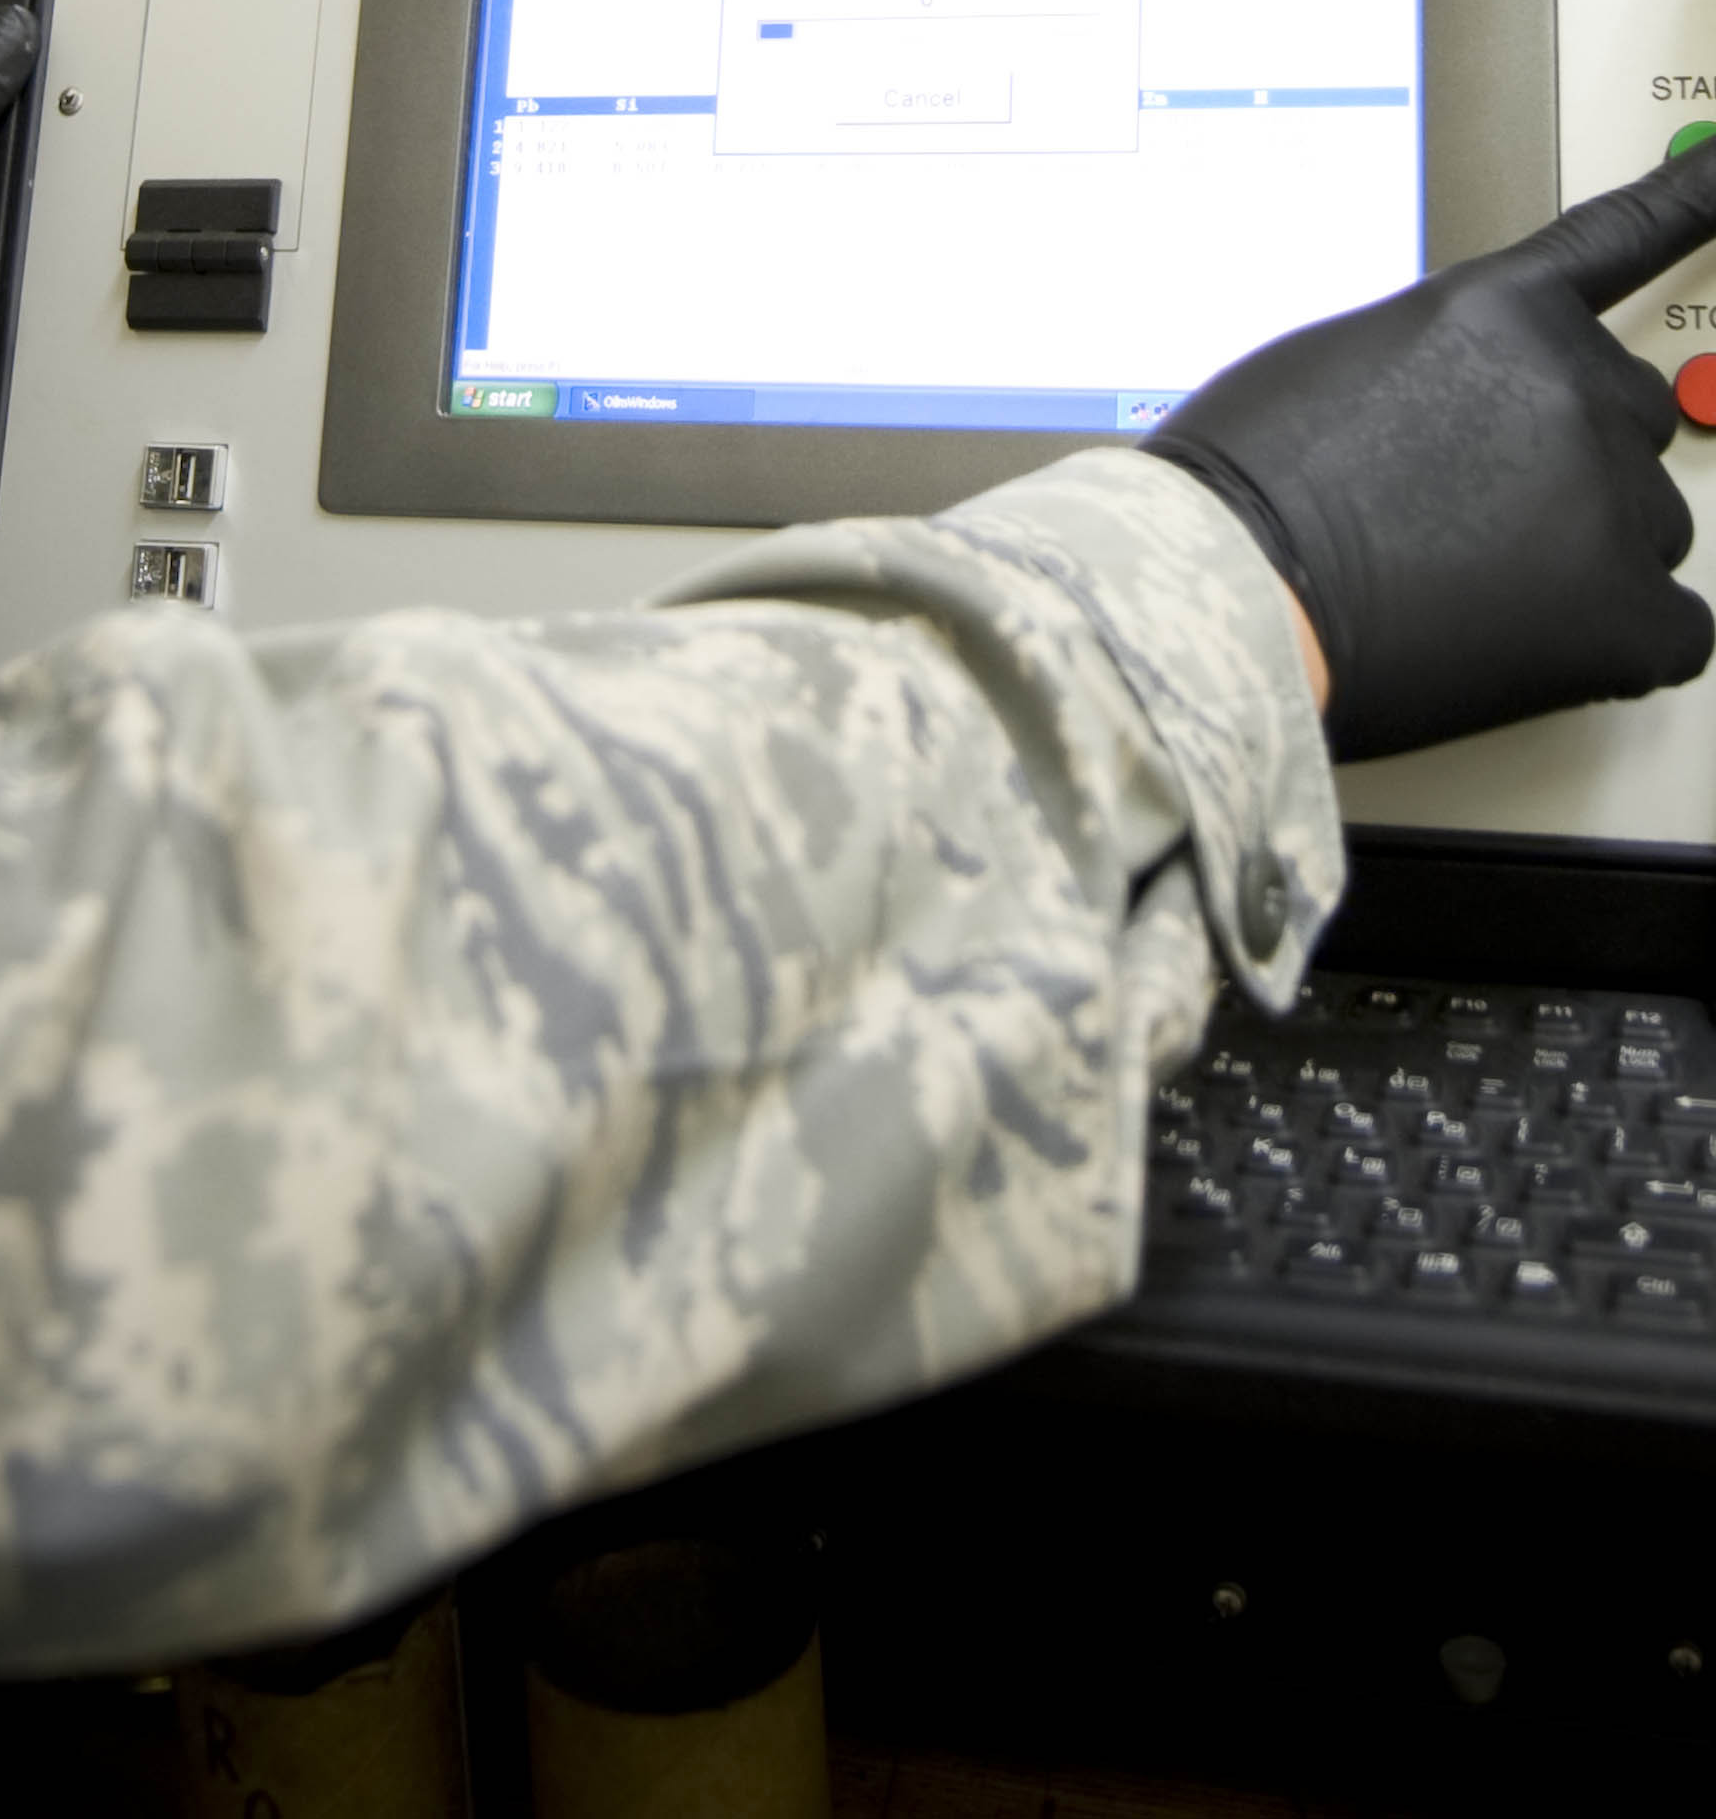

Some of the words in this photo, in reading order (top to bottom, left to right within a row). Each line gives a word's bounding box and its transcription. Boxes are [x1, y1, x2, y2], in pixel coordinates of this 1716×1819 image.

[517, 99, 539, 113] Pb
[616, 98, 639, 112] Si
[883, 87, 963, 108] Cancel
[492, 141, 503, 154] 2
[490, 162, 501, 175] 3
[489, 390, 532, 407] start
[1451, 996, 1488, 1012] F10
[1539, 1003, 1572, 1018] F11
[1625, 1009, 1662, 1025] F12
